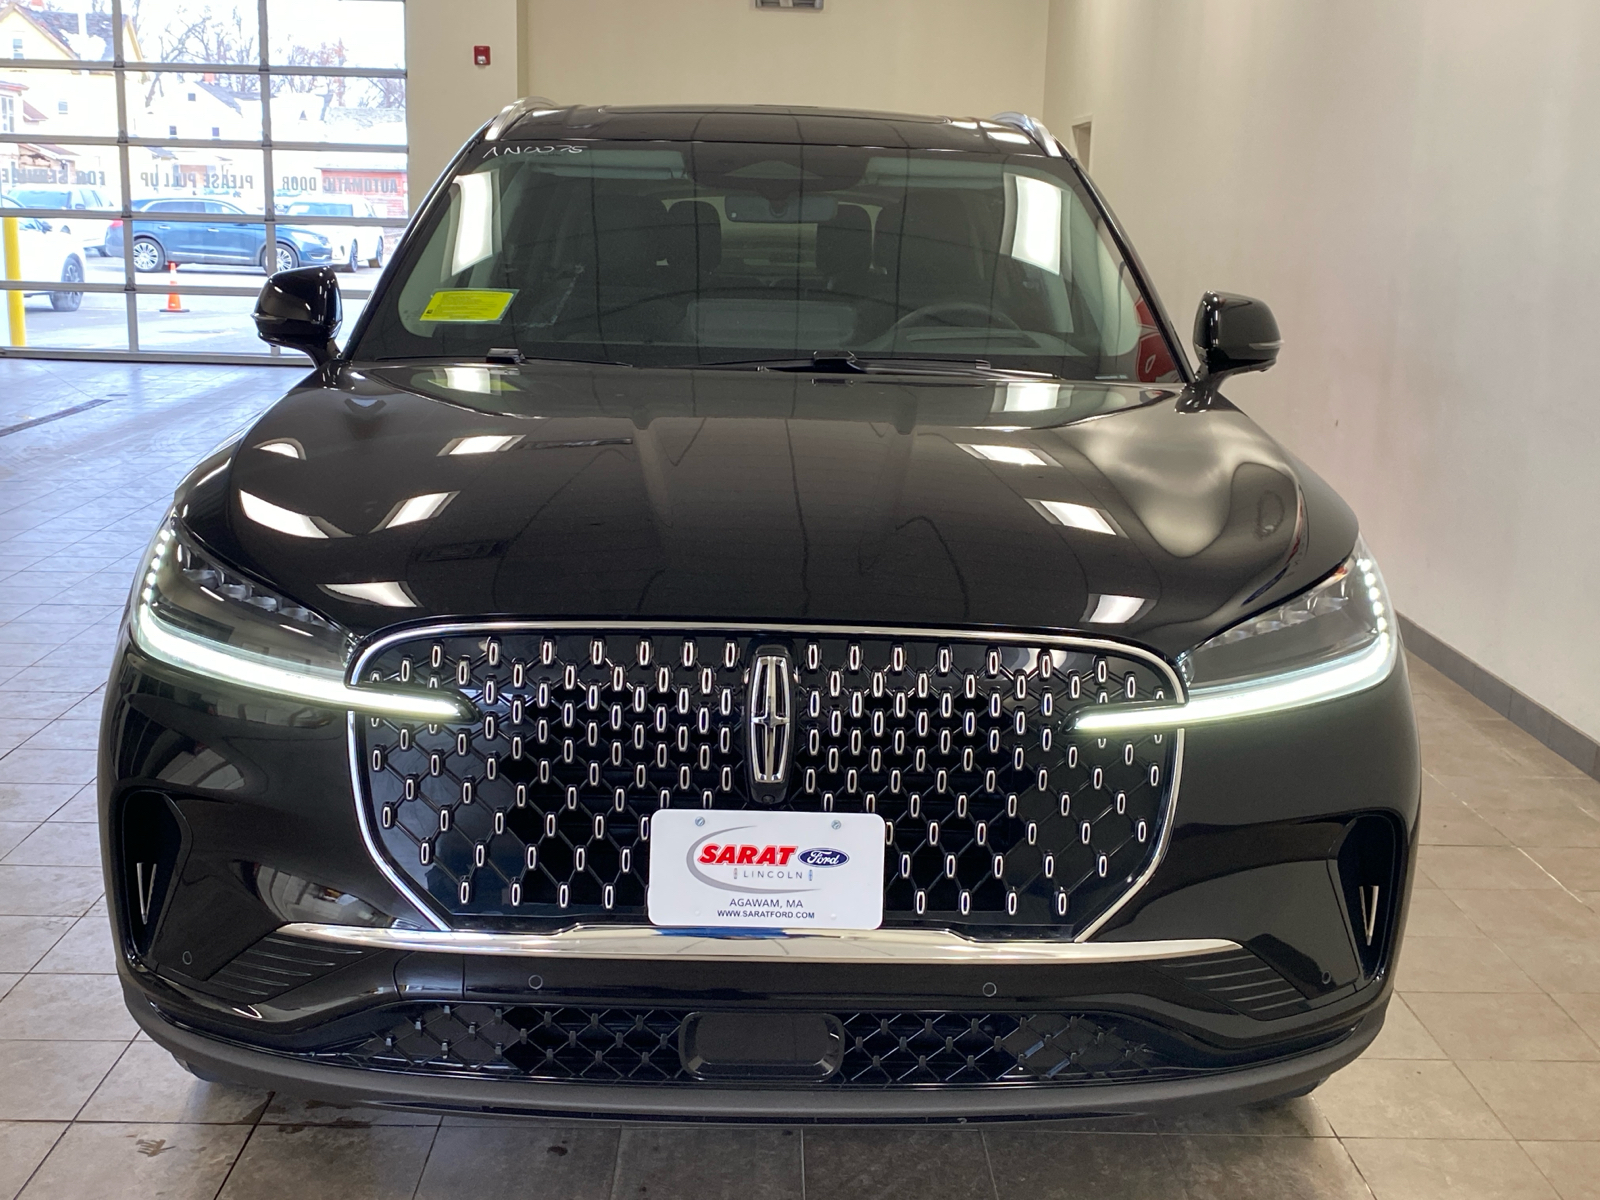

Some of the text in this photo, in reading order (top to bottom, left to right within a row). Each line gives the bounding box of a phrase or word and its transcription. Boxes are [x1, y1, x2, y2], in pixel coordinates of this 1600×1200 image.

[697, 843, 841, 866] SARAT Ford
[743, 870, 803, 879] LINCOLN
[729, 898, 804, 909] AGAWAM, MA
[716, 910, 815, 919] WWW.SARATFORD.COM
